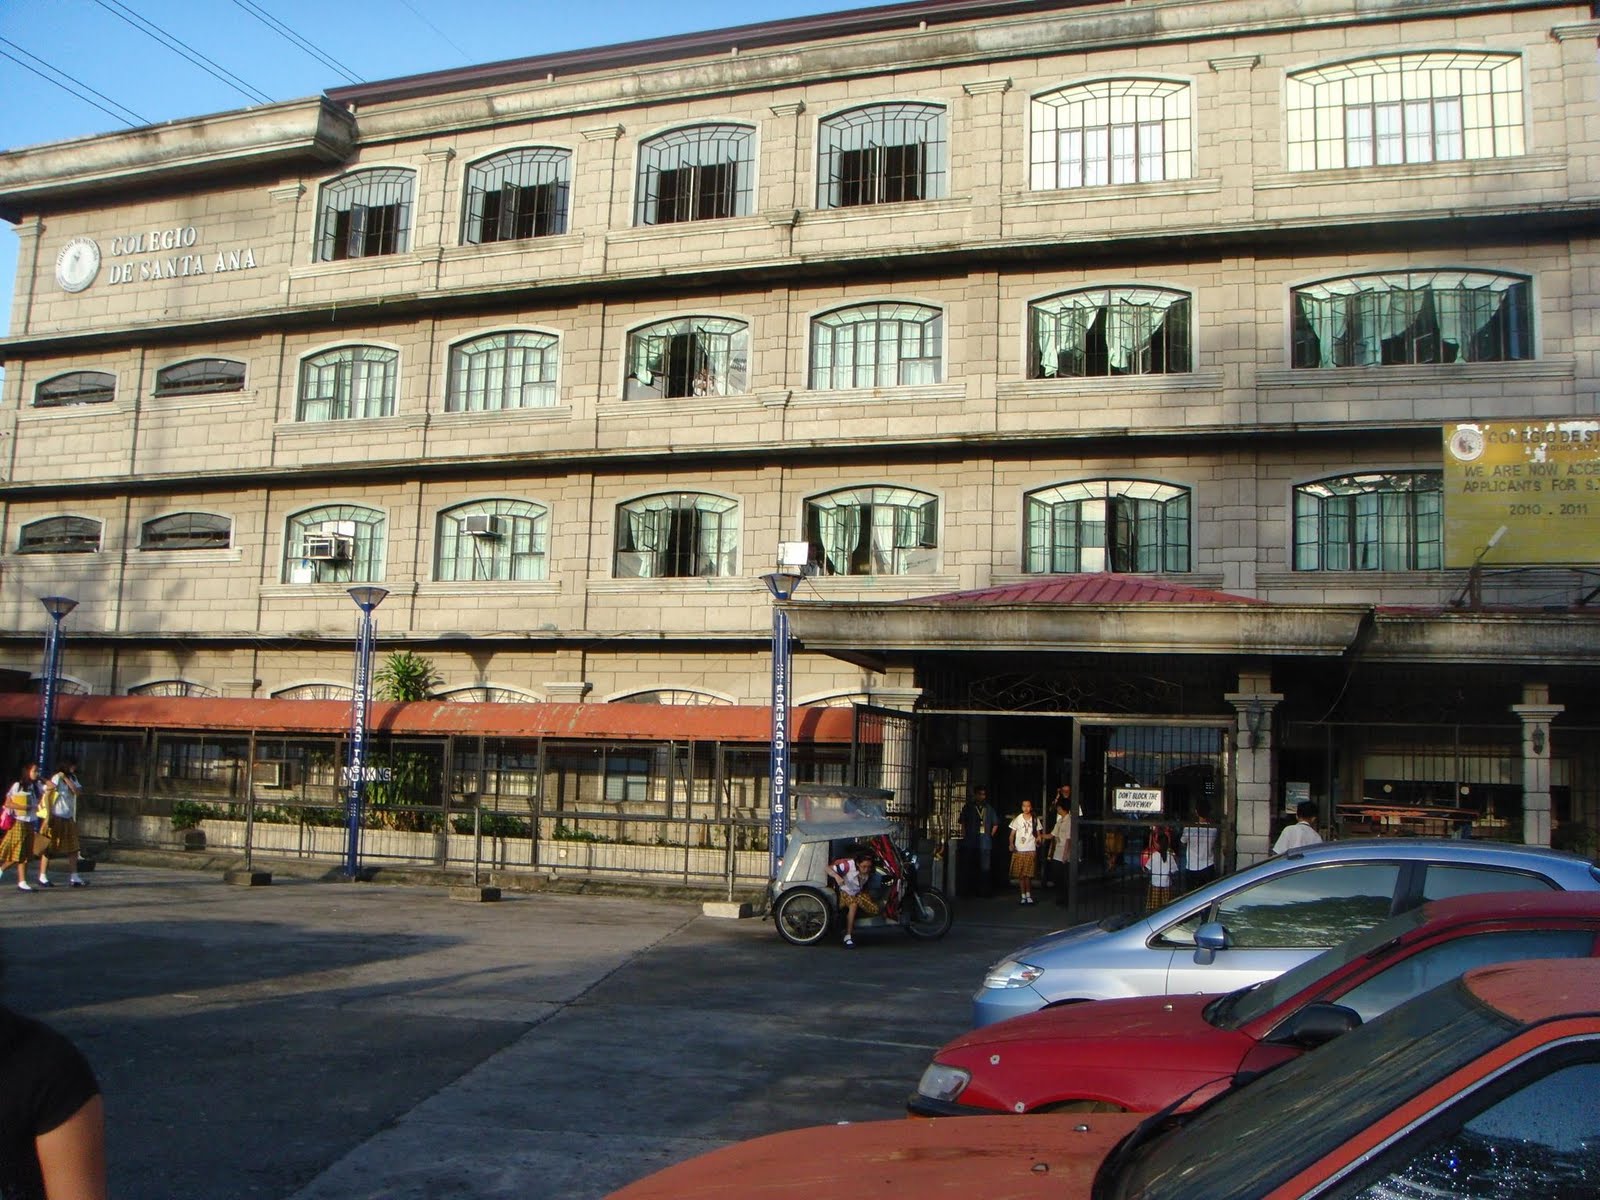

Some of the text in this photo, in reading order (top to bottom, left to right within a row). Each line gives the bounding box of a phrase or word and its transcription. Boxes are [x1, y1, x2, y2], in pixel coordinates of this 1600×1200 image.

[111, 226, 198, 257] COLEGIO
[109, 262, 134, 285] DE
[139, 255, 206, 281] SANTA
[214, 248, 258, 273] ANA
[1488, 430, 1556, 444] COLEGIO
[1561, 430, 1580, 442] DE
[1464, 465, 1484, 477] WE
[1494, 464, 1521, 477] ARE
[1528, 463, 1558, 476] NOW
[1463, 479, 1600, 493] APPLICANTS FOR S.
[1509, 503, 1541, 516] 2010
[1560, 503, 1588, 516] 2011
[351, 684, 365, 799] FORWARD TAGUIG
[774, 684, 785, 813] FORWARD TAGUIG
[1118, 791, 1159, 800] DON'T BLOCK THE
[1123, 800, 1153, 808] DRIVEWAY
